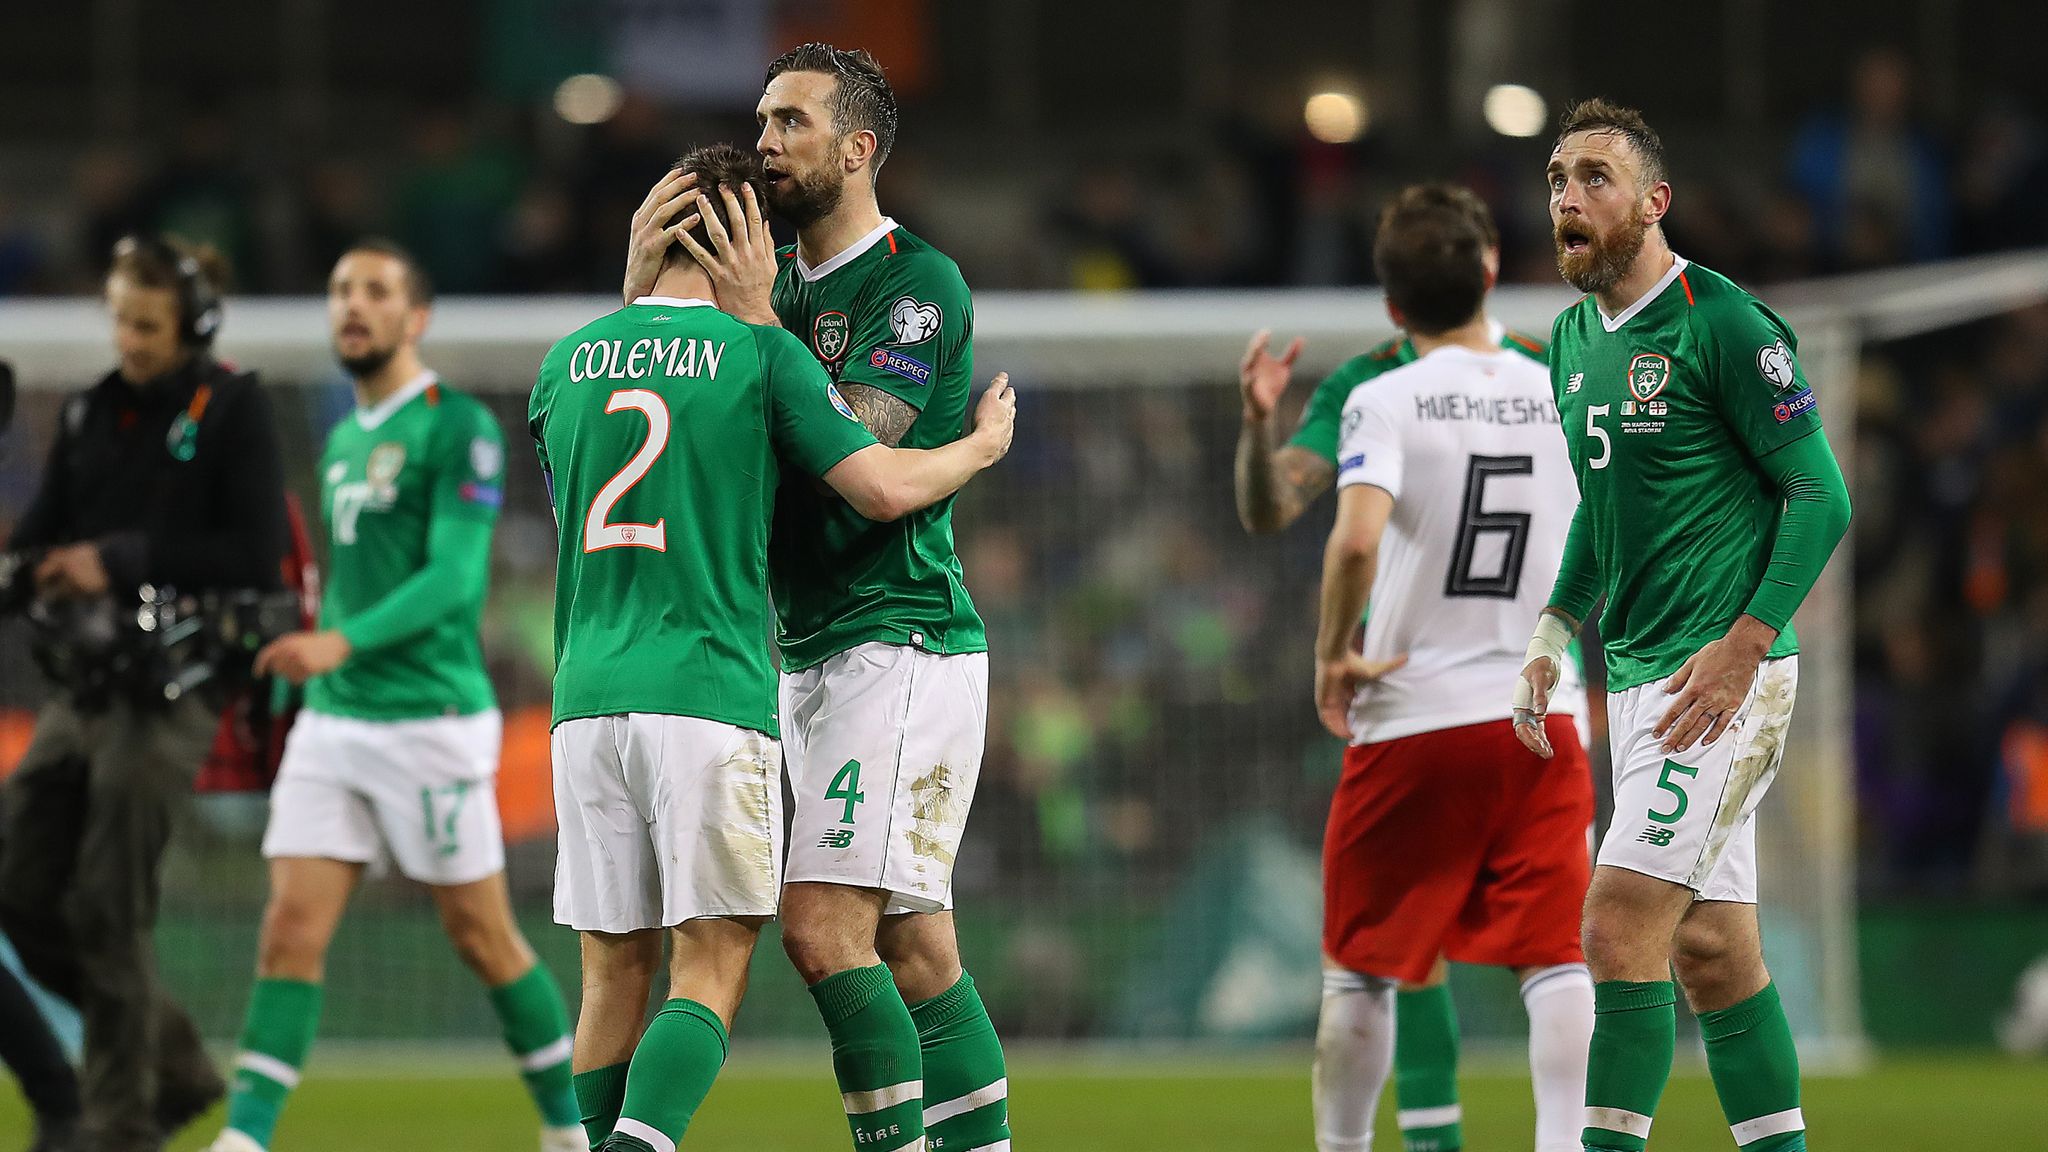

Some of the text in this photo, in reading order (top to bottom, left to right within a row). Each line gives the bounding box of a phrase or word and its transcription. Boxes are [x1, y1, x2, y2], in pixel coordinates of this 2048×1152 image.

[569, 337, 726, 383] COLEMAN
[887, 356, 930, 380] RESPECT
[1637, 360, 1663, 369] Ireland
[1788, 392, 1816, 413] RESPEC
[1586, 403, 1612, 470] 5
[584, 388, 671, 553] 2
[1443, 455, 1533, 600] 6
[422, 781, 468, 858] 17
[824, 758, 865, 825] 4
[1647, 758, 1699, 825] 5
